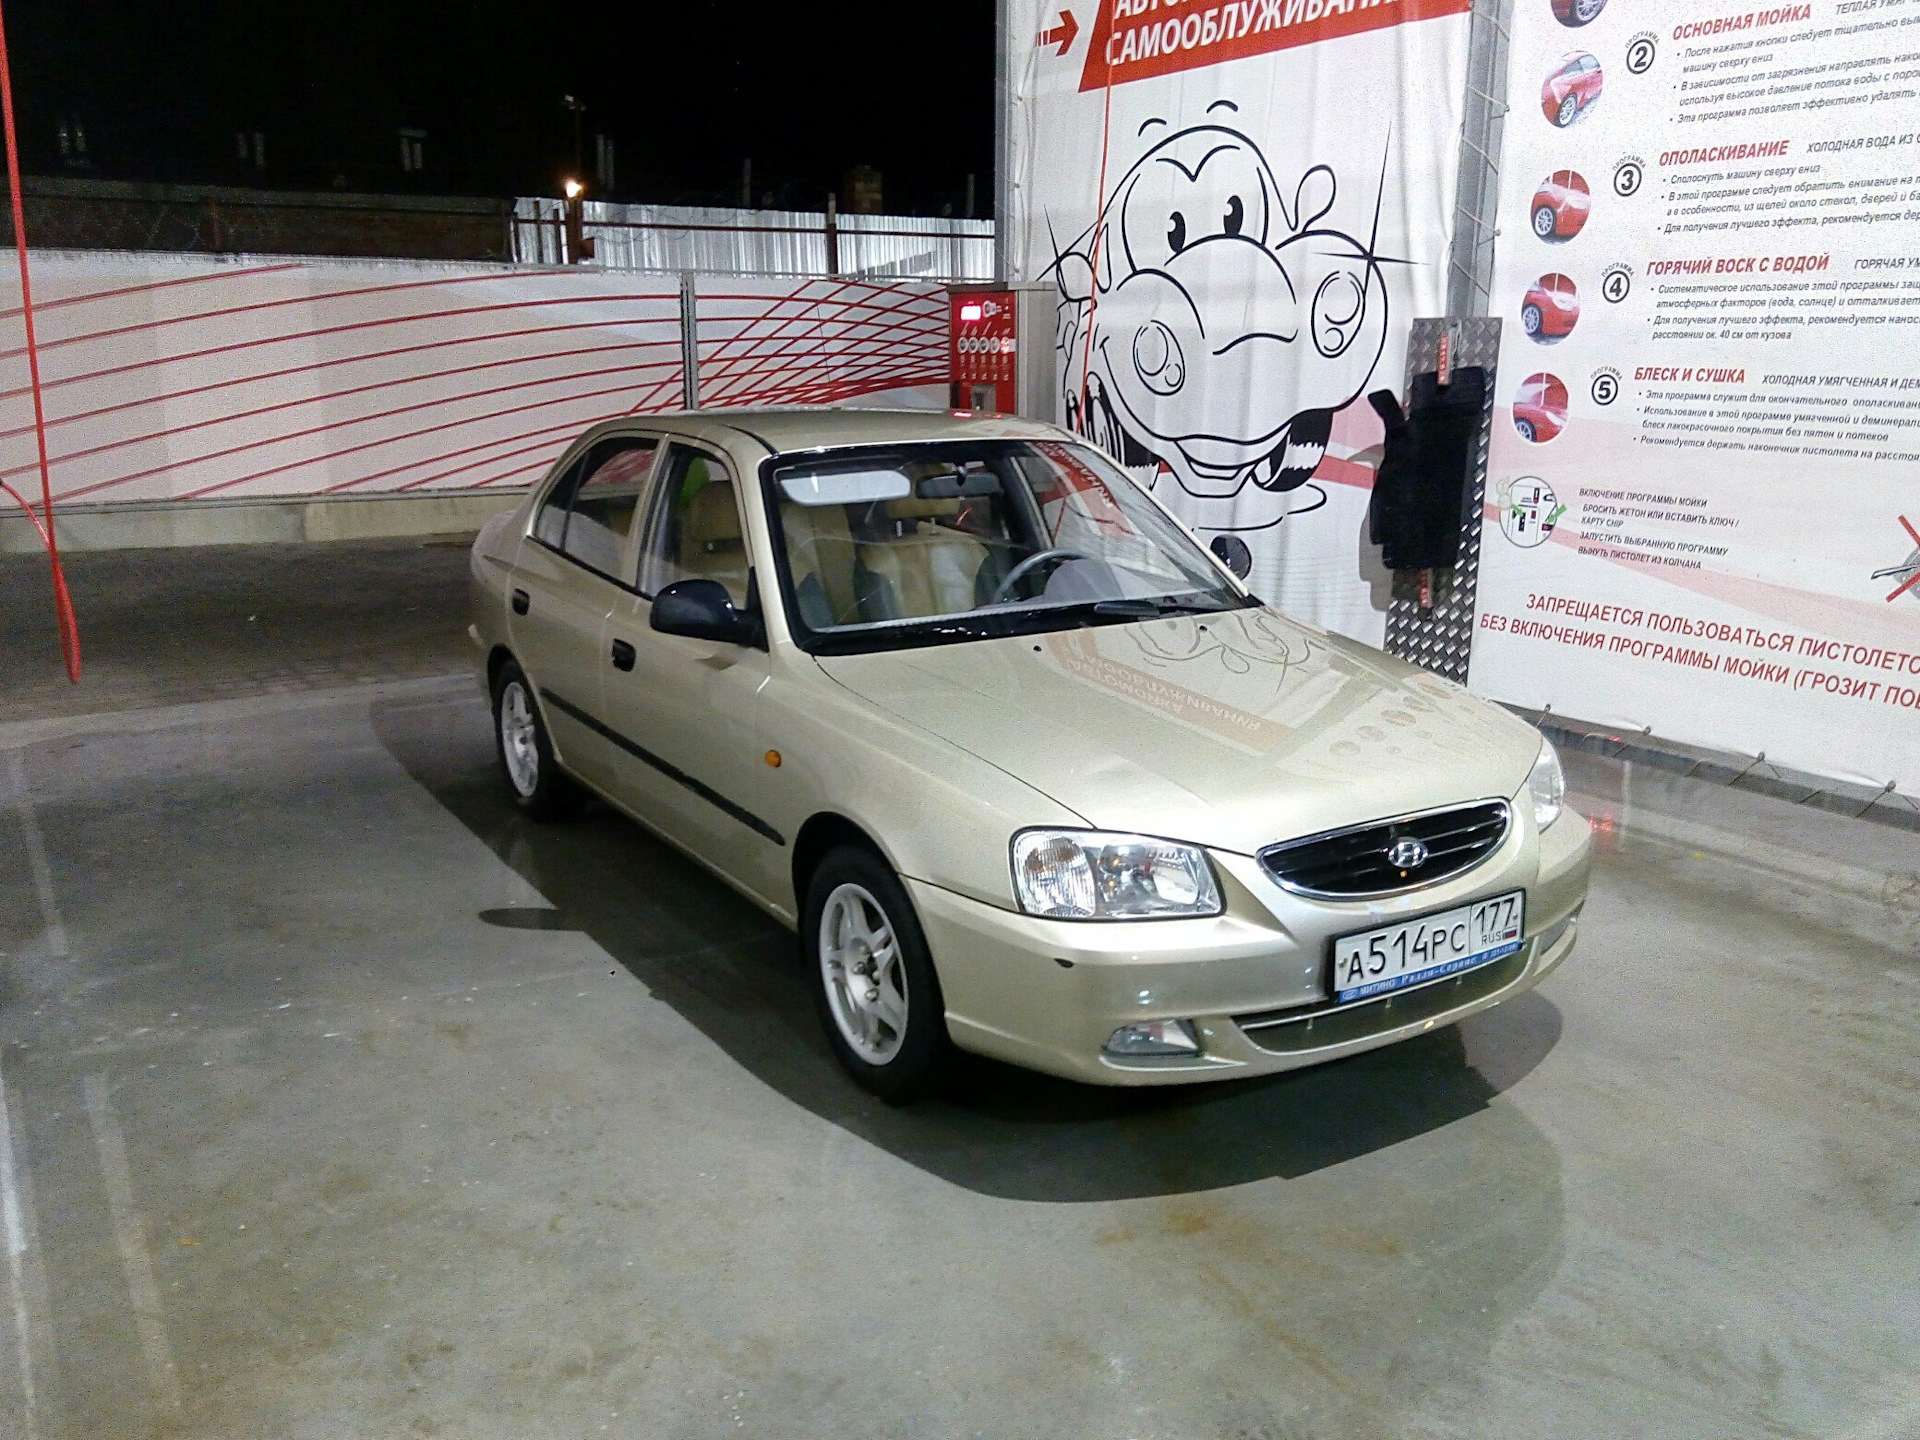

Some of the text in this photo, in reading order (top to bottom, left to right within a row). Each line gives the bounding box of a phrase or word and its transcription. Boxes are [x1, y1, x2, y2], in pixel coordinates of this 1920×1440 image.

[1836, 0, 1876, 15] ТЕПЛАЯ
[1673, 4, 1811, 40] ОСНОВНАЯ МОЙКА
[1105, 0, 1397, 66] САМООБЛУЖИВА
[1625, 31, 1660, 48] ПРОГРАММА
[1685, 20, 1898, 58] После нажатия кнопки следует тщательно
[1634, 46, 1648, 68] 2
[1683, 53, 1773, 73] машину сверху вниз
[1681, 56, 1891, 91] В зависимости от загрязнения направлять
[1679, 72, 1890, 106] используя высокое давление потока воды с
[1677, 89, 1916, 123] Эта программа позволяет эффективно удалять
[1659, 139, 1790, 167] ОПОЛАСКИВАНИЕ
[1807, 133, 1913, 153] ХОЛОДНАЯ ВОДА ИЗ
[1612, 155, 1646, 171] ПРОГРАММА
[1621, 169, 1634, 190] 3
[1670, 165, 1820, 184] Сполоснуть машину сверху вниз
[1669, 192, 1675, 201] В
[1677, 190, 1699, 200] этой
[1701, 188, 1749, 200] программе
[1752, 185, 1791, 196] следует
[1795, 182, 1845, 193] обратить
[1848, 177, 1898, 188] внимание
[1900, 176, 1913, 184] на
[1681, 192, 1898, 214] особенности, из щелей около стекол, дверей
[1664, 211, 1900, 235] Для получения лучшего эффекта, рекомендуется
[1601, 262, 1634, 278] ПРОГРАММА
[1646, 252, 1830, 275] ГОРЯЧИЙ ВОСК С ВОДОЙ
[1854, 258, 1905, 269] ГОРЯЧАЯ
[1609, 277, 1622, 297] 4
[1659, 281, 1899, 294] Систематическое использование этой программы
[1657, 299, 1718, 309] атмосферных
[1720, 298, 1766, 309] факторов
[1769, 297, 1796, 308] (вода,
[1799, 297, 1836, 308] солнце)
[1653, 314, 1886, 326] Для получения лучшего эффекта, рекомендуется
[1652, 331, 1704, 340] расстоянии
[1705, 331, 1717, 339] ок.
[1720, 330, 1730, 338] 40
[1745, 331, 1759, 339] от
[1760, 331, 1792, 341] кузова
[1590, 365, 1623, 381] ПРОГРАММА
[1634, 366, 1746, 383] БЛЕСК И СУШКА
[1762, 374, 1816, 387] ХОЛОДНАЯ
[1819, 376, 1888, 388] УМЯГЧЕННАЯ
[1890, 378, 1898, 388] И
[1598, 381, 1611, 400] 5
[1646, 390, 1847, 406] Эта программа служит для окончательного
[1643, 405, 1859, 424] Использование этой программе умягченной и
[1642, 420, 1889, 442] блеск лакокрасочного покрытия без пятен и потеков
[1640, 435, 1705, 448] Рекомендуется
[1707, 439, 1745, 450] держать
[1748, 443, 1800, 454] наконечник
[1802, 447, 1858, 458] пистолета
[1861, 450, 1872, 459] на
[1579, 488, 1707, 507] ВКЛЮЧЕНИЕ ПРОГРАММЫ МОЙКИ
[1581, 516, 1624, 528] КАРТУ CHIP
[1583, 504, 1734, 527] БРОСИТЬ ЖЕТОН ИЛИ ВСТАВИТЬ КЛЮЧ
[1580, 531, 1728, 556] ЗАПУСТИТЬ ВЫБРАННУЮ ПРОГРАММУ
[1578, 546, 1701, 569] ВЫНУТЬ ПИСТОЛЕТ ИЗ КОЛЧАНА
[1526, 594, 1643, 627] ЗАПРЕЩАЕТСЯ
[1647, 613, 1794, 652] ПОЛЬЗОВАТЬСЯ
[1480, 613, 1507, 631] БЕЗ
[1510, 619, 1605, 650] ВКЛЮЧЕНИЯ
[1608, 636, 1720, 671] ПРОГРАММЫ
[1723, 657, 1790, 683] МОЙКИ
[1793, 669, 1881, 700] (ГРОЗИТ
[1473, 897, 1516, 933] 177
[1481, 931, 1502, 946] RUS
[1361, 979, 1396, 995] МИТИНО
